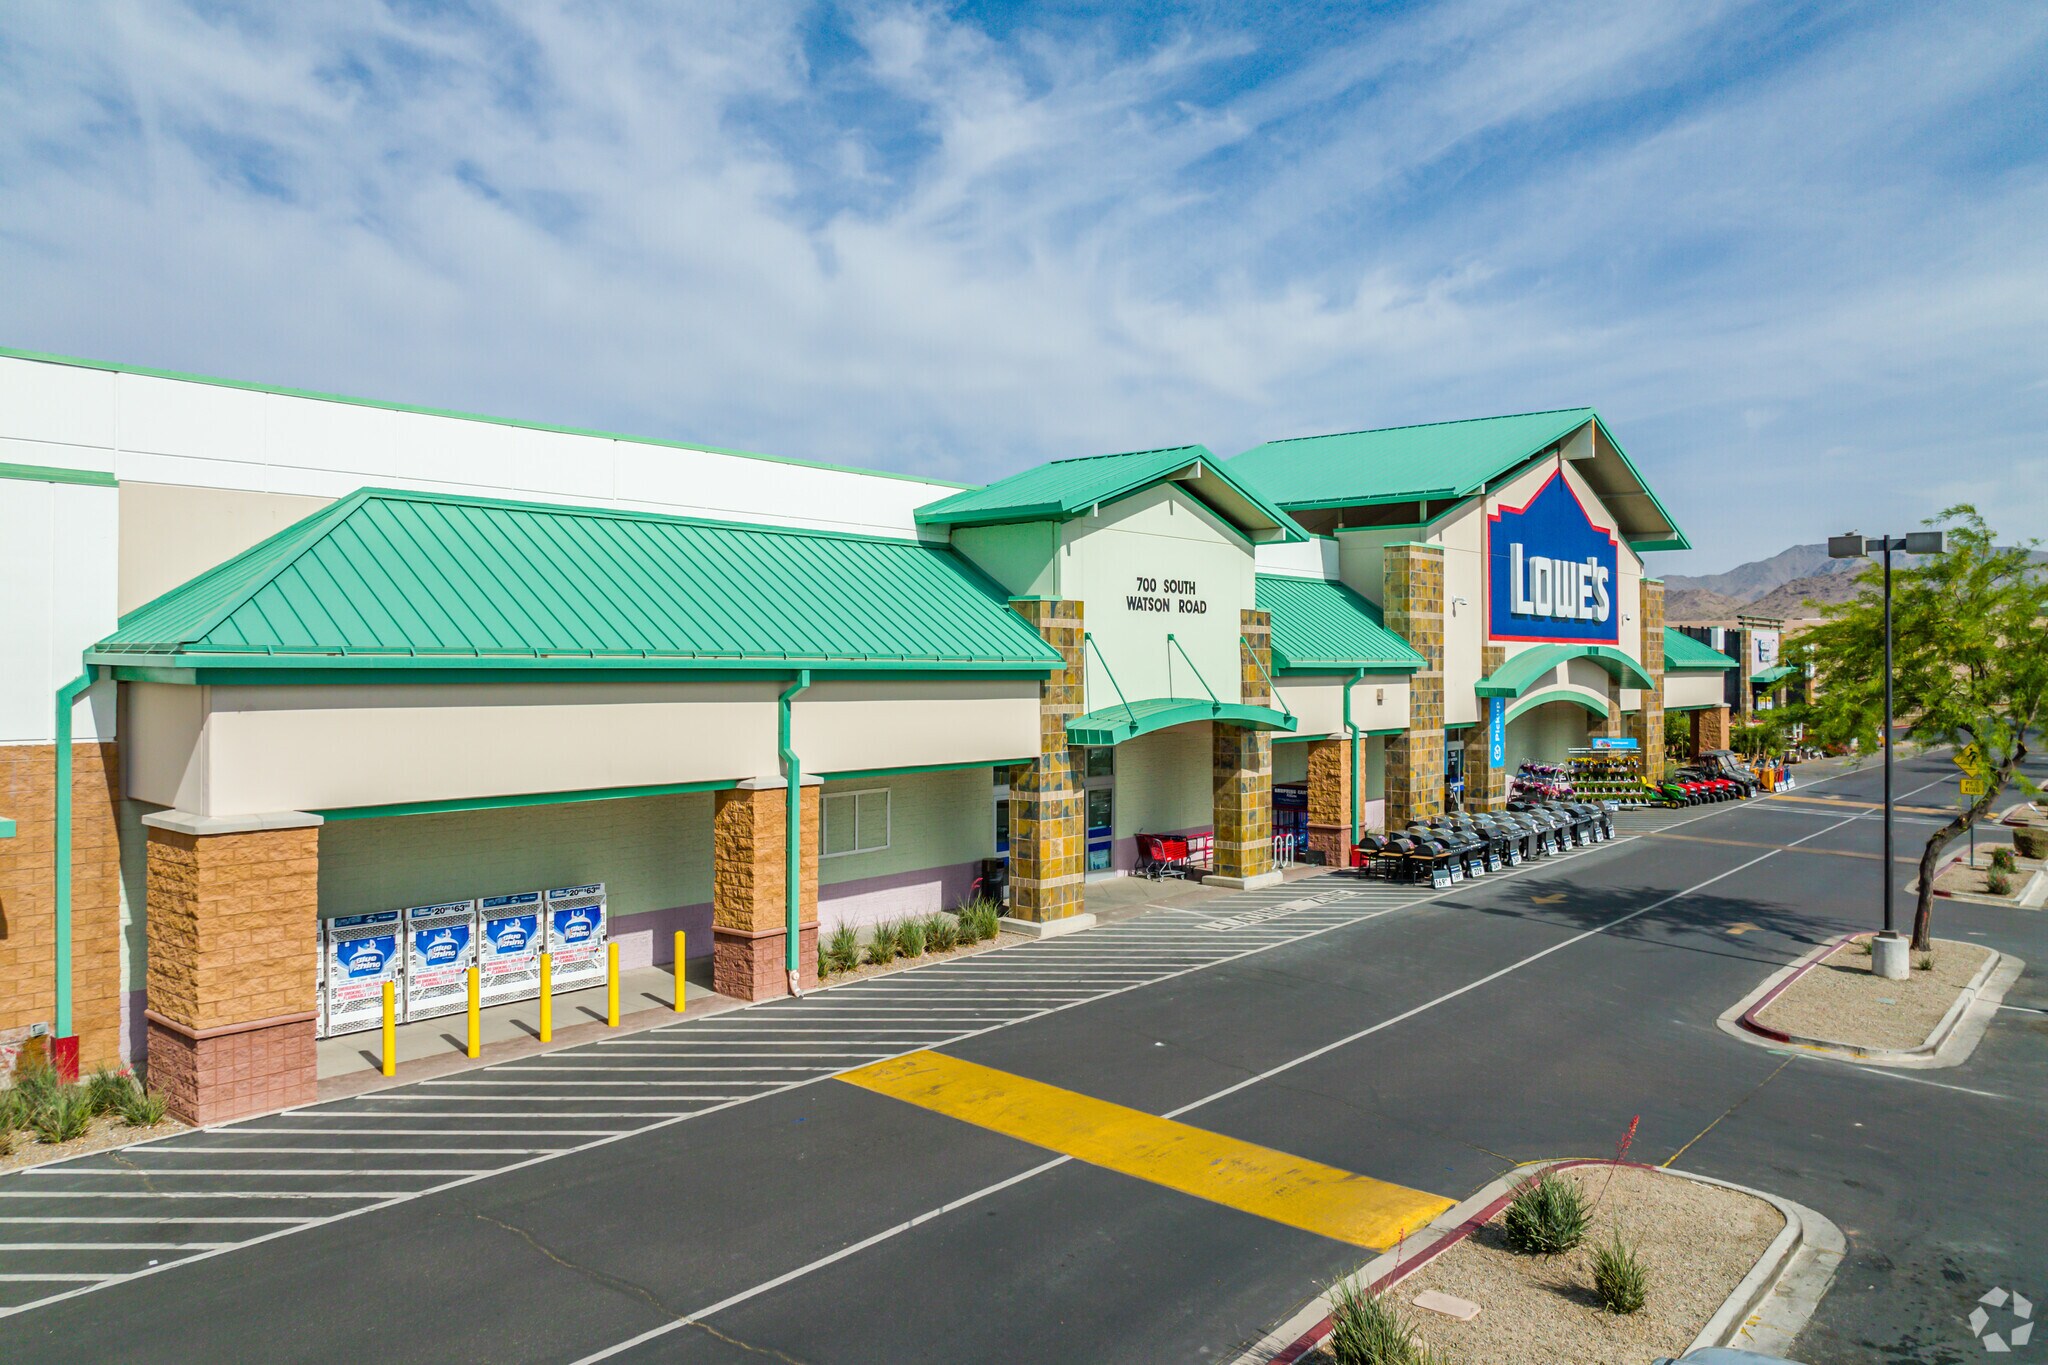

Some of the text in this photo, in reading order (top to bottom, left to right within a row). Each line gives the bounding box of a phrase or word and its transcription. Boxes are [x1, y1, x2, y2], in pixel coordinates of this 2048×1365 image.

[1136, 577, 1196, 595] 700 SOUTH
[1510, 543, 1609, 623] LOWE'S
[1126, 595, 1207, 614] WATSON ROAD
